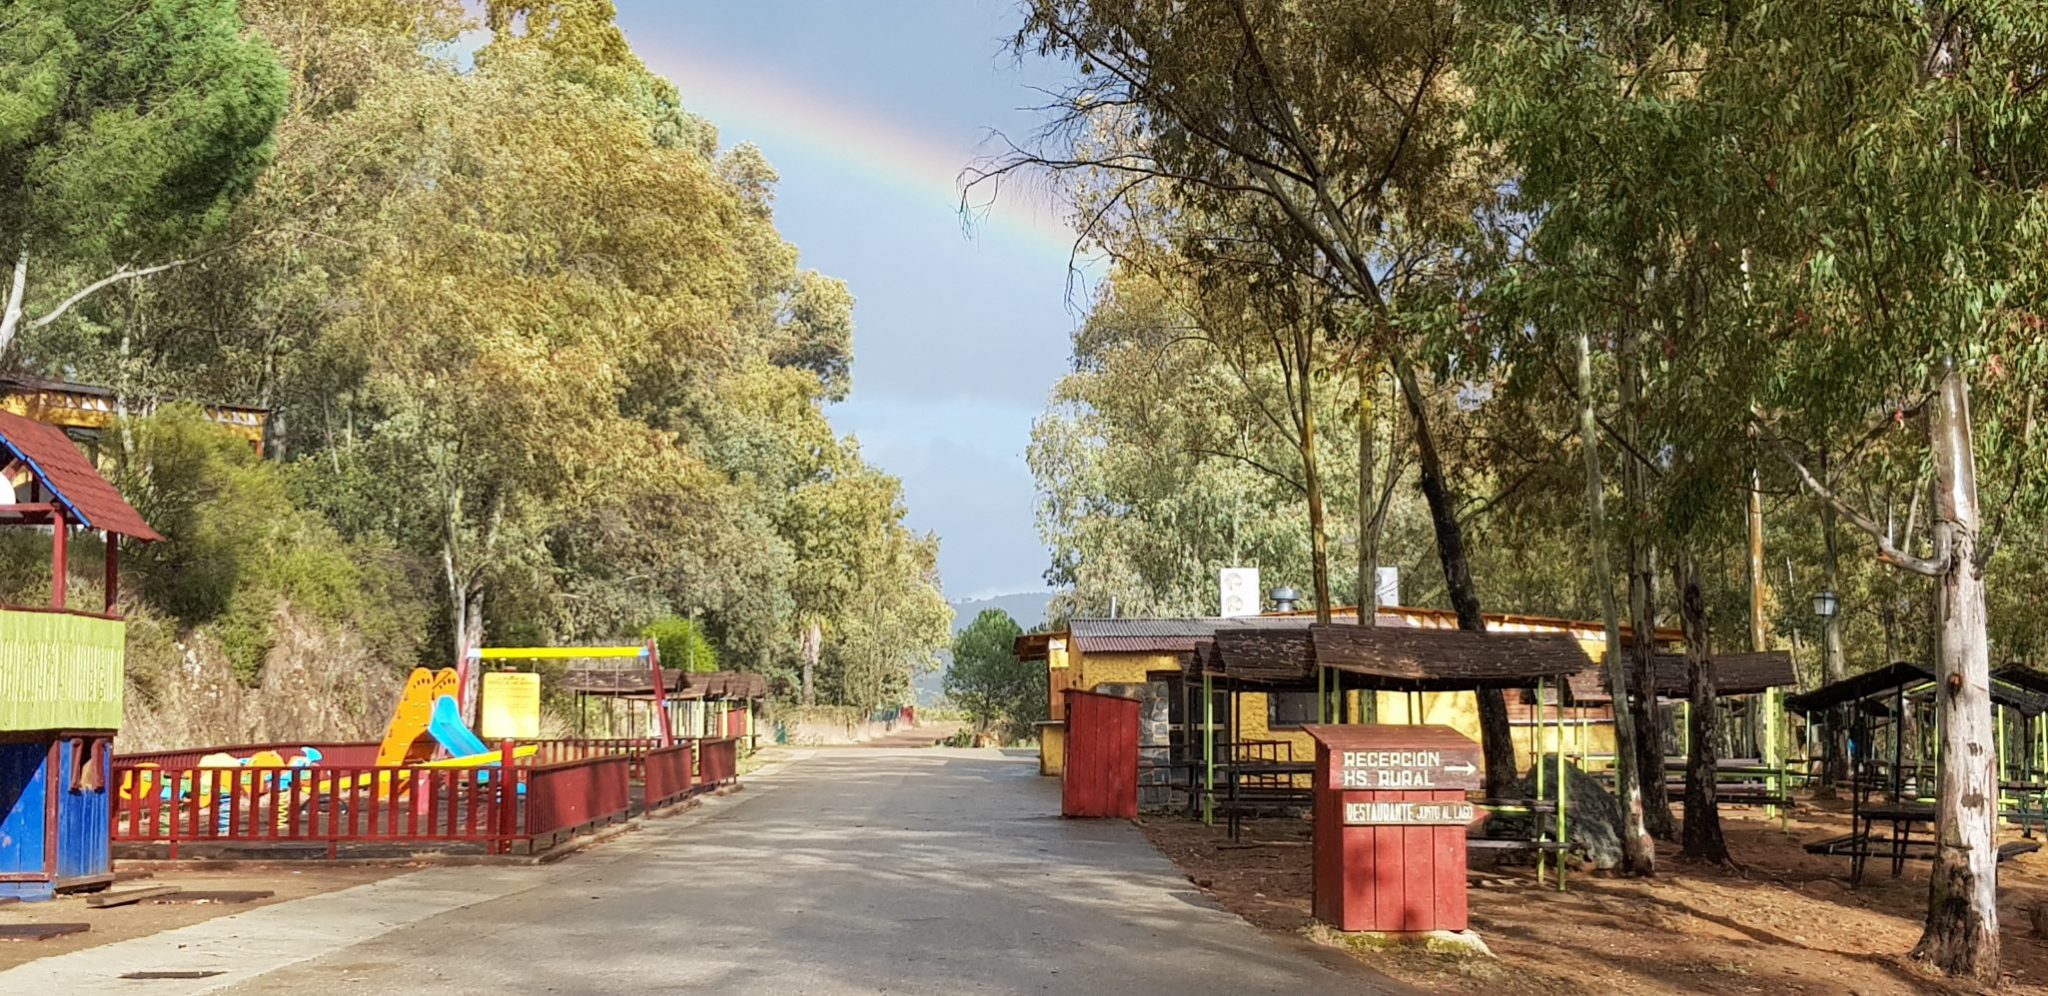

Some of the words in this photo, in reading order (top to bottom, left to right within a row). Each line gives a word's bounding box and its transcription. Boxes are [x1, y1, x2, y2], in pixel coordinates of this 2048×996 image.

[1343, 750, 1439, 767] RECEPCIÓN
[1343, 770, 1371, 786] HS.
[1378, 769, 1435, 786] RURAL
[1346, 803, 1414, 821] RESTAURANTE
[1417, 805, 1440, 820] JUNTO
[1442, 806, 1452, 819] AL
[1454, 806, 1473, 819] LAGO
